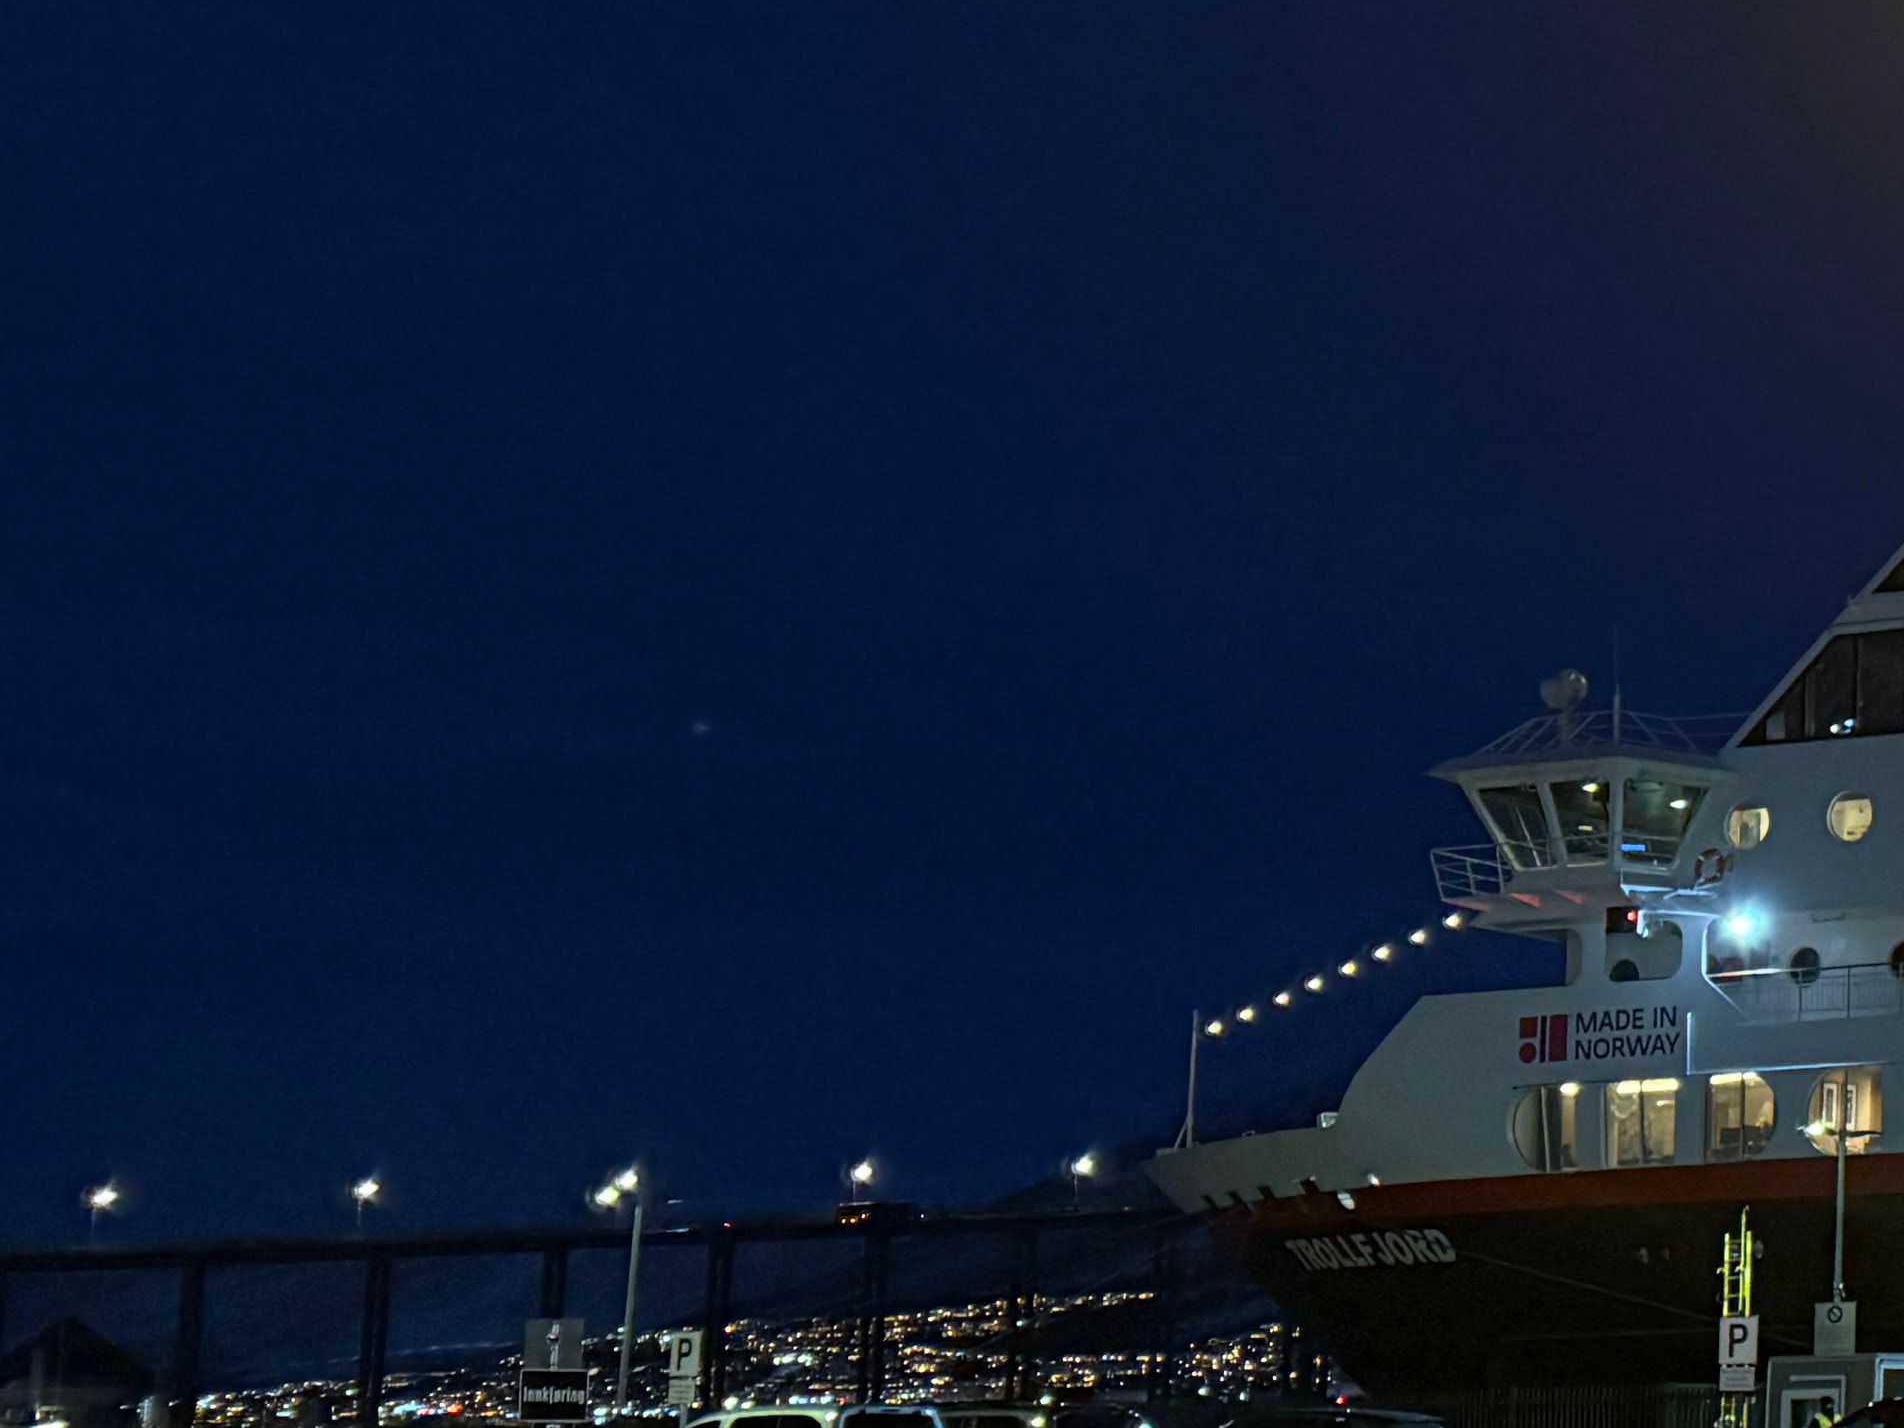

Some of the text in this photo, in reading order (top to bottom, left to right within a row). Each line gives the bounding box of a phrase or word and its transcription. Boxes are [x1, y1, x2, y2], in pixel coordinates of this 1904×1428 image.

[1576, 1006, 1677, 1034] MADE IN
[1575, 1033, 1680, 1060] NORWAY
[1284, 1229, 1456, 1271] TROLLFJORD
[676, 1338, 691, 1371] P
[1728, 1324, 1748, 1358] P
